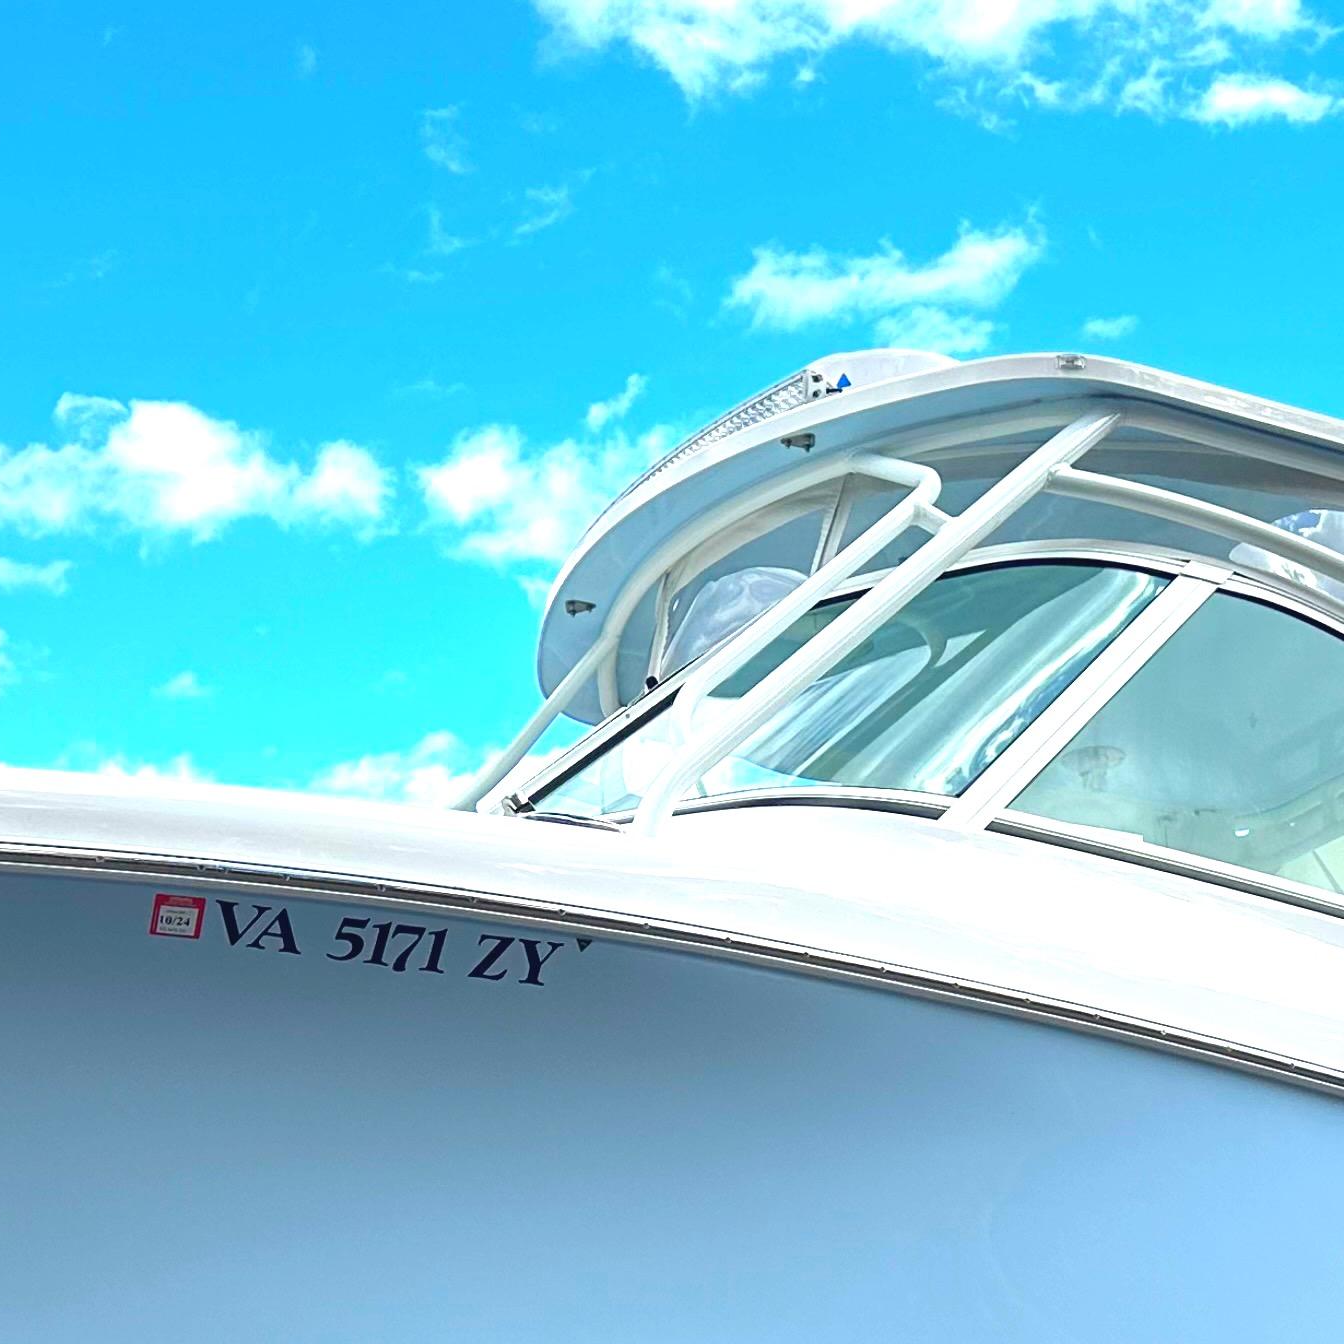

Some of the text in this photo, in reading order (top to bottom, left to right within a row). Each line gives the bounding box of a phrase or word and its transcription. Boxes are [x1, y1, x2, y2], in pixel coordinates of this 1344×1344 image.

[159, 915, 191, 927] 10/24
[215, 899, 565, 987] VA 5171 ZY
